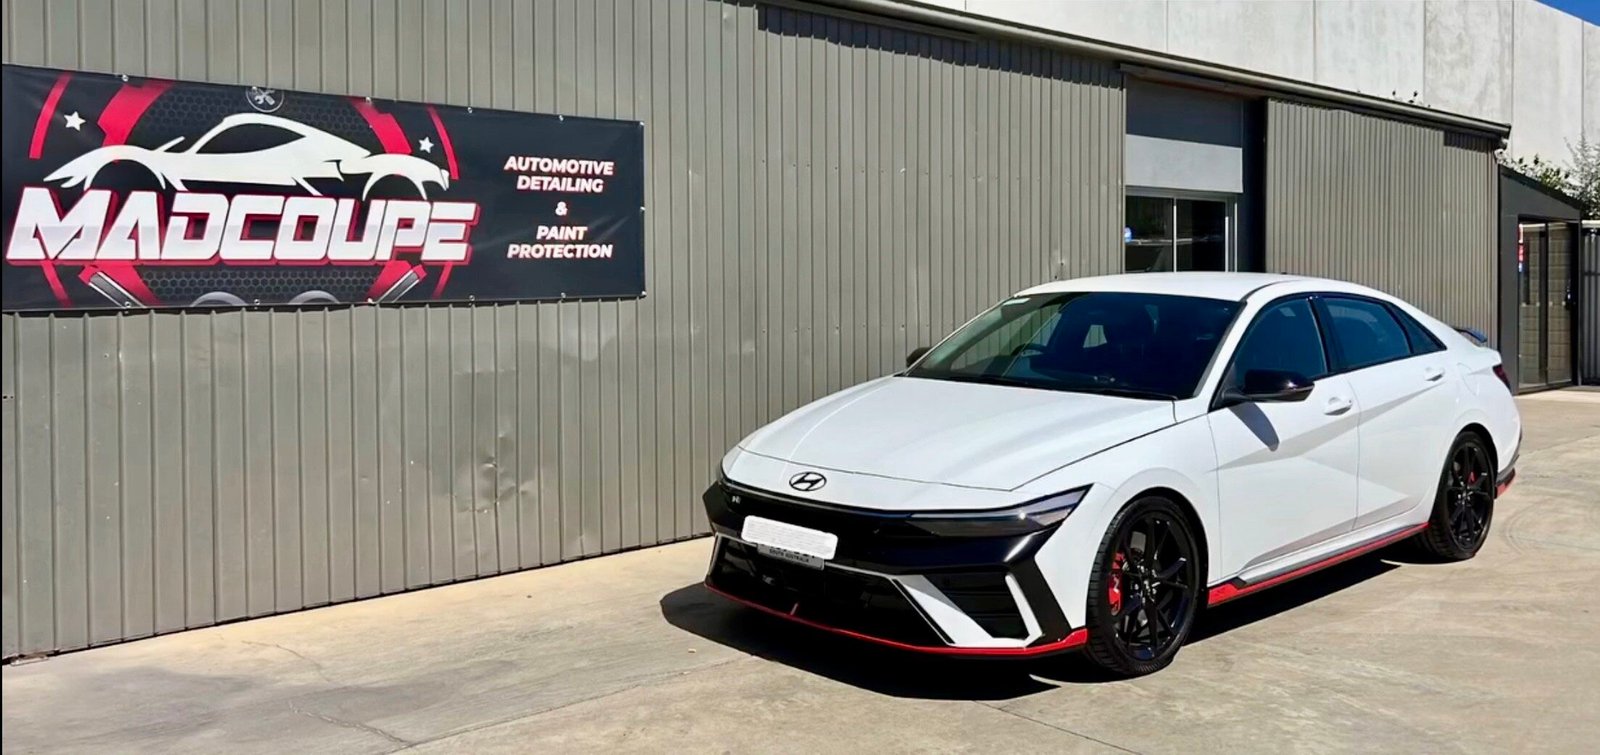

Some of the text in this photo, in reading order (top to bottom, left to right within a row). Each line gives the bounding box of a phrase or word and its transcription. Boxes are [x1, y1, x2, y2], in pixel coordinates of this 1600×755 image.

[503, 156, 614, 176] AUTOMOTIVE
[516, 175, 604, 193] DETAILING
[555, 201, 568, 216] &
[6, 186, 478, 264] MADCOUPE
[536, 225, 588, 240] PAINT
[507, 244, 613, 259] PROTECTION
